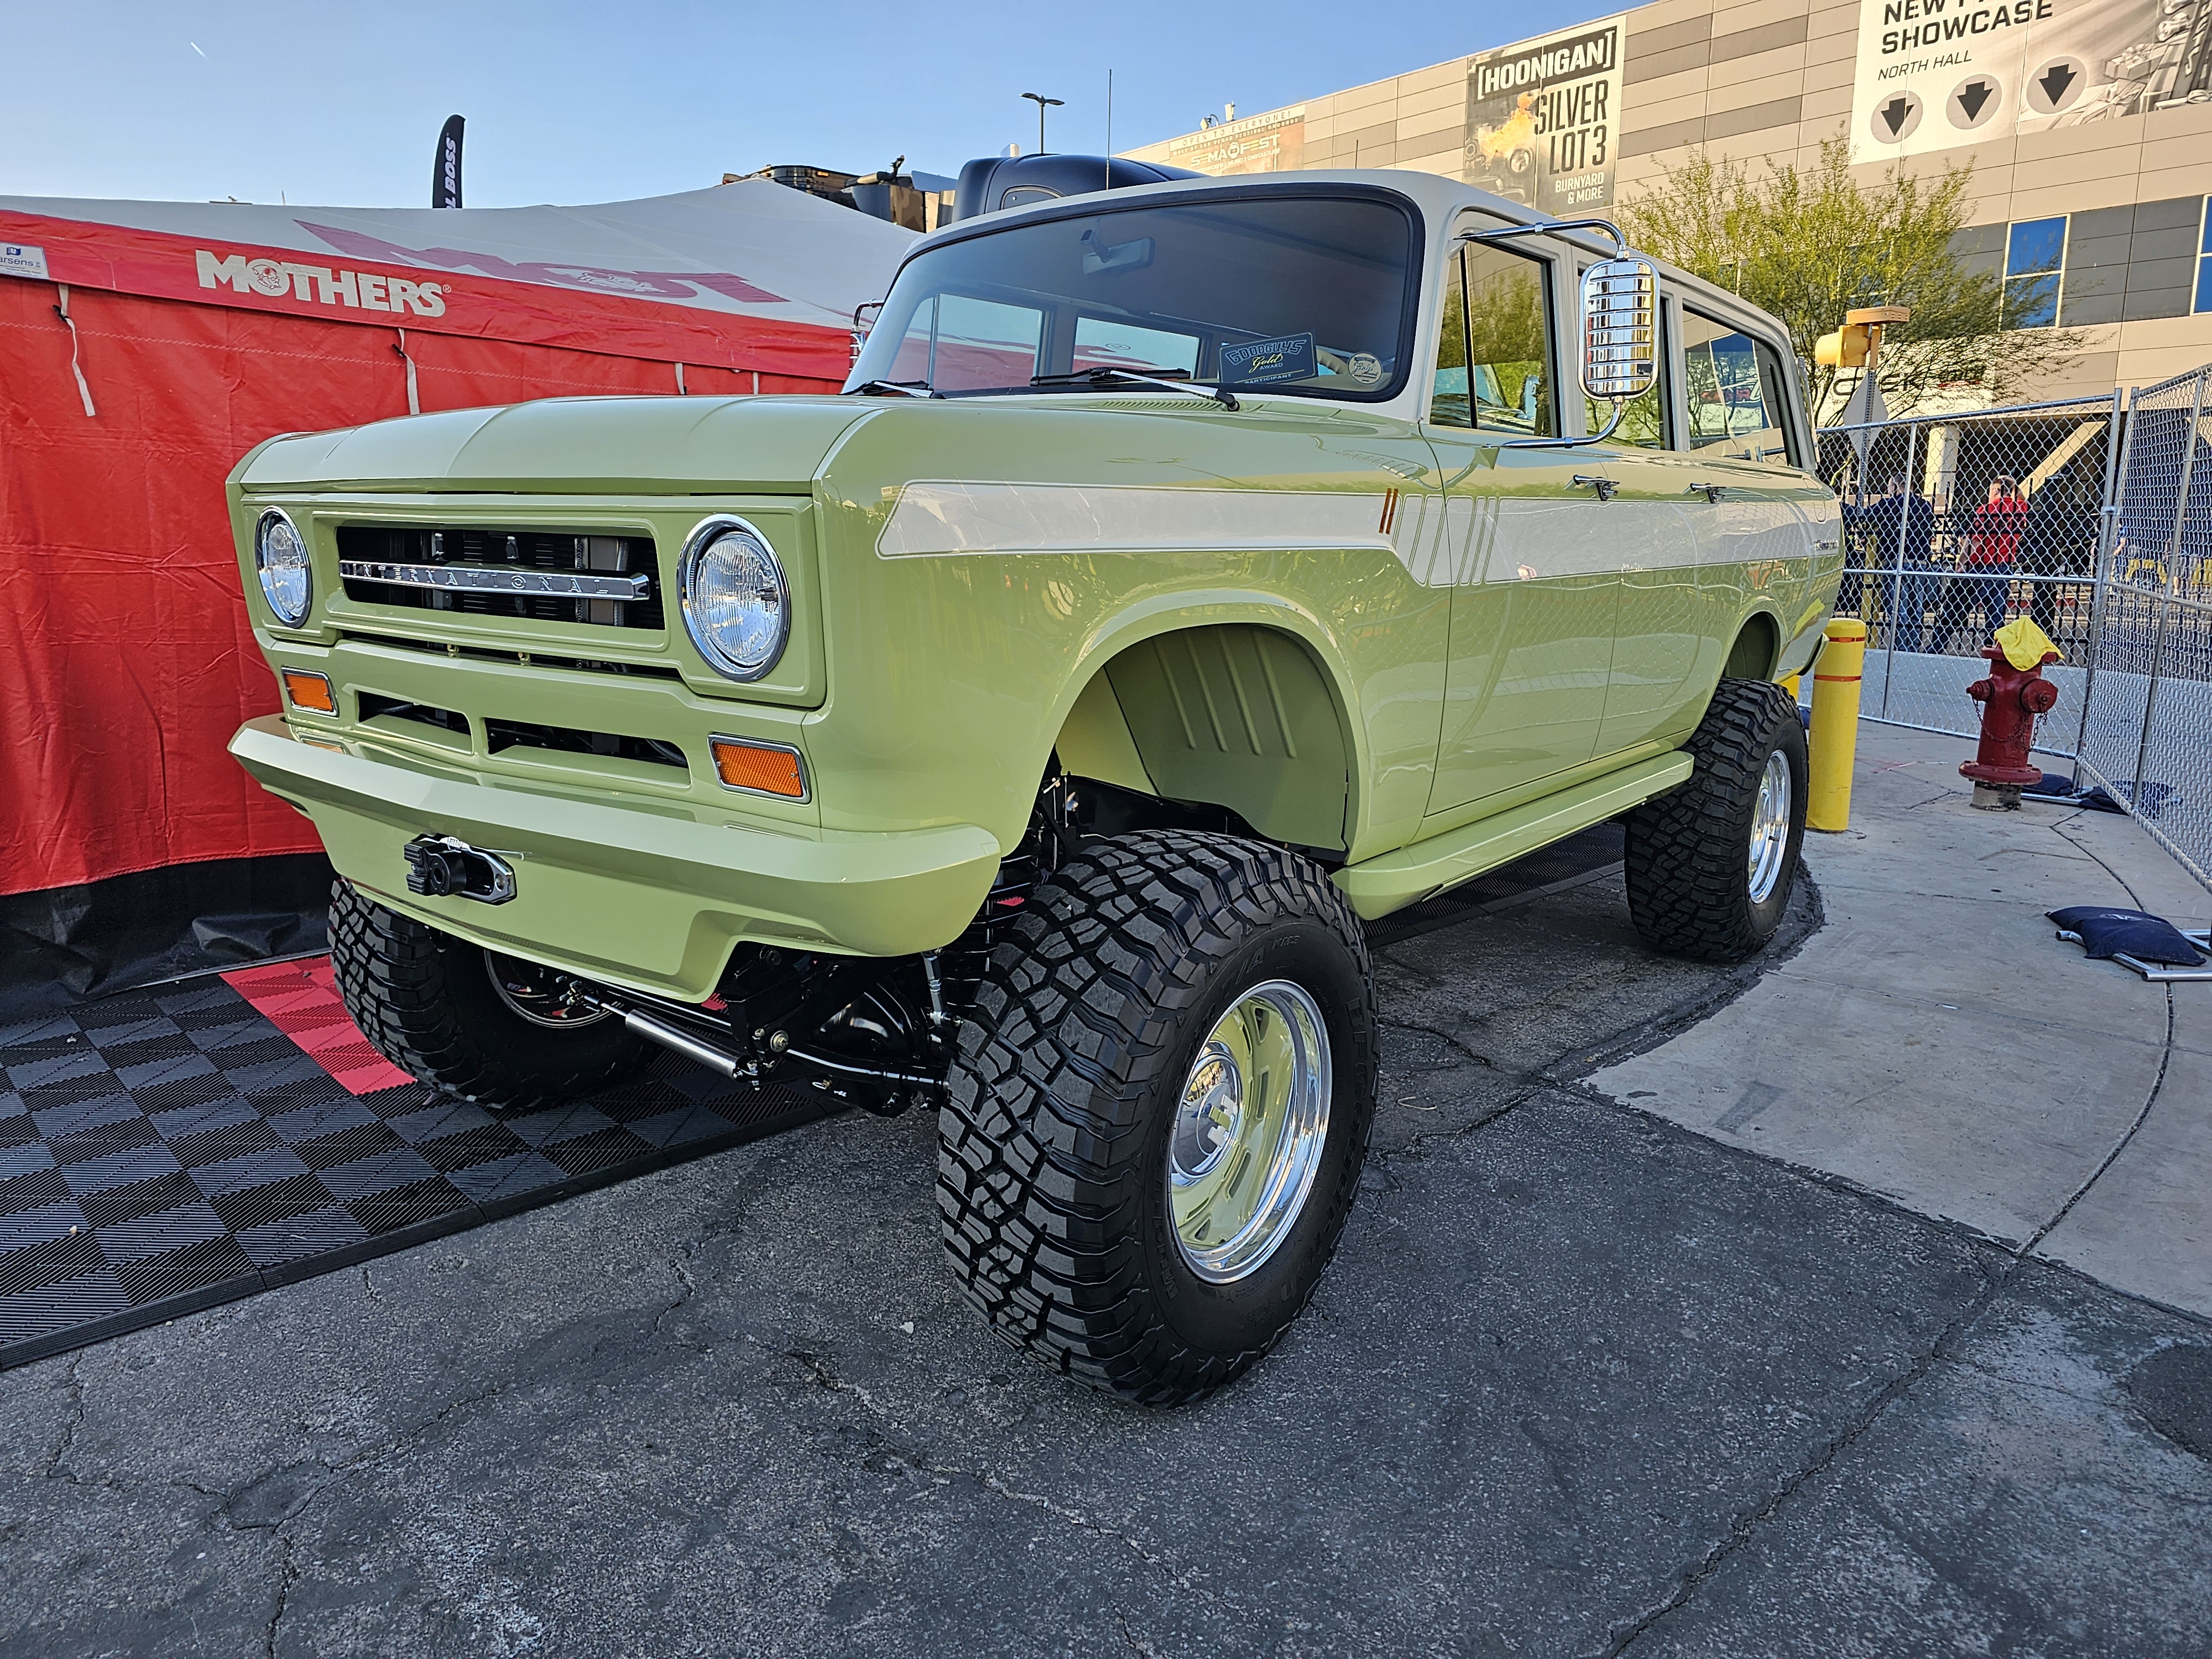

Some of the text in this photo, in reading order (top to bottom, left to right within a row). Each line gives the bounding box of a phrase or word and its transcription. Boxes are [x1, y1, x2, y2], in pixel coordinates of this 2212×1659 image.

[1884, 0, 1945, 25] NEW
[1882, 0, 2053, 54] SHOWCASE
[1878, 50, 1972, 81] NORTH HALL
[1534, 79, 1609, 135] SILVER
[1183, 134, 1207, 145] OPEN
[1232, 111, 1290, 133] EVERYONE!
[1213, 135, 1233, 145] VEGAS
[1235, 127, 1265, 139] FESTIVAL
[1191, 134, 1280, 167] SEMA FEST
[1550, 124, 1607, 175] LOT 3
[445, 137, 456, 194] BOSS
[1555, 171, 1604, 193] BURNYARD
[1567, 185, 1604, 204] & MORE
[1225, 339, 1307, 365] GOODGUYS
[1249, 353, 1283, 373] Gold
[1244, 374, 1292, 384] PARTICIPANT
[1259, 362, 1283, 371] AWARD
[352, 564, 609, 595] INTERNATIONAL
